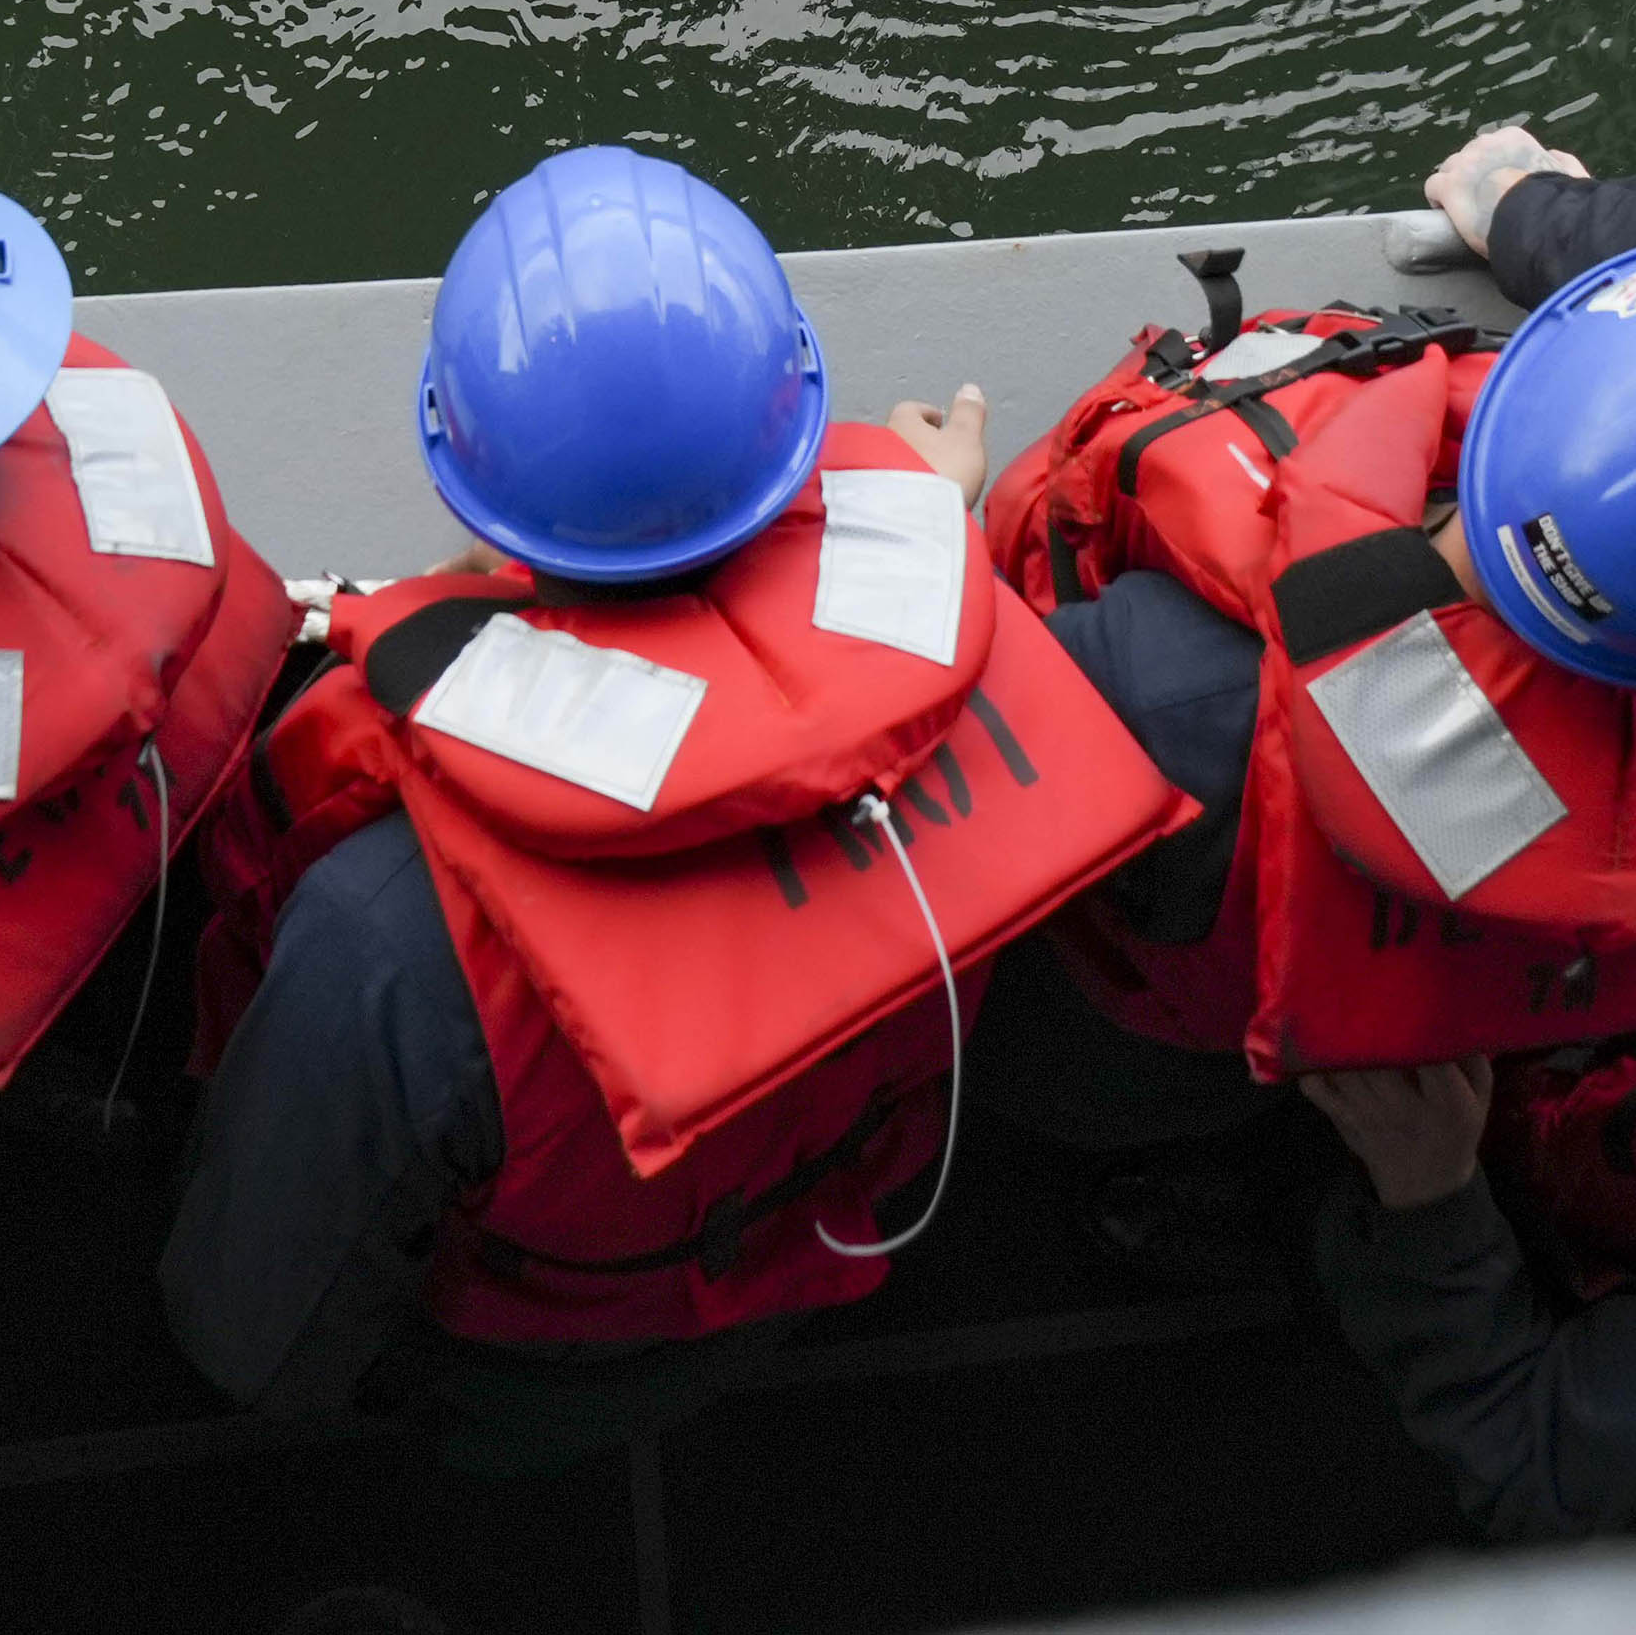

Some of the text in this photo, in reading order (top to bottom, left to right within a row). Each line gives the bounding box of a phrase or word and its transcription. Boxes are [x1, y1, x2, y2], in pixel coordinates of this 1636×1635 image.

[1538, 514, 1571, 562] DON'T
[1533, 542, 1557, 574] THE
[1549, 571, 1583, 607] SHIP
